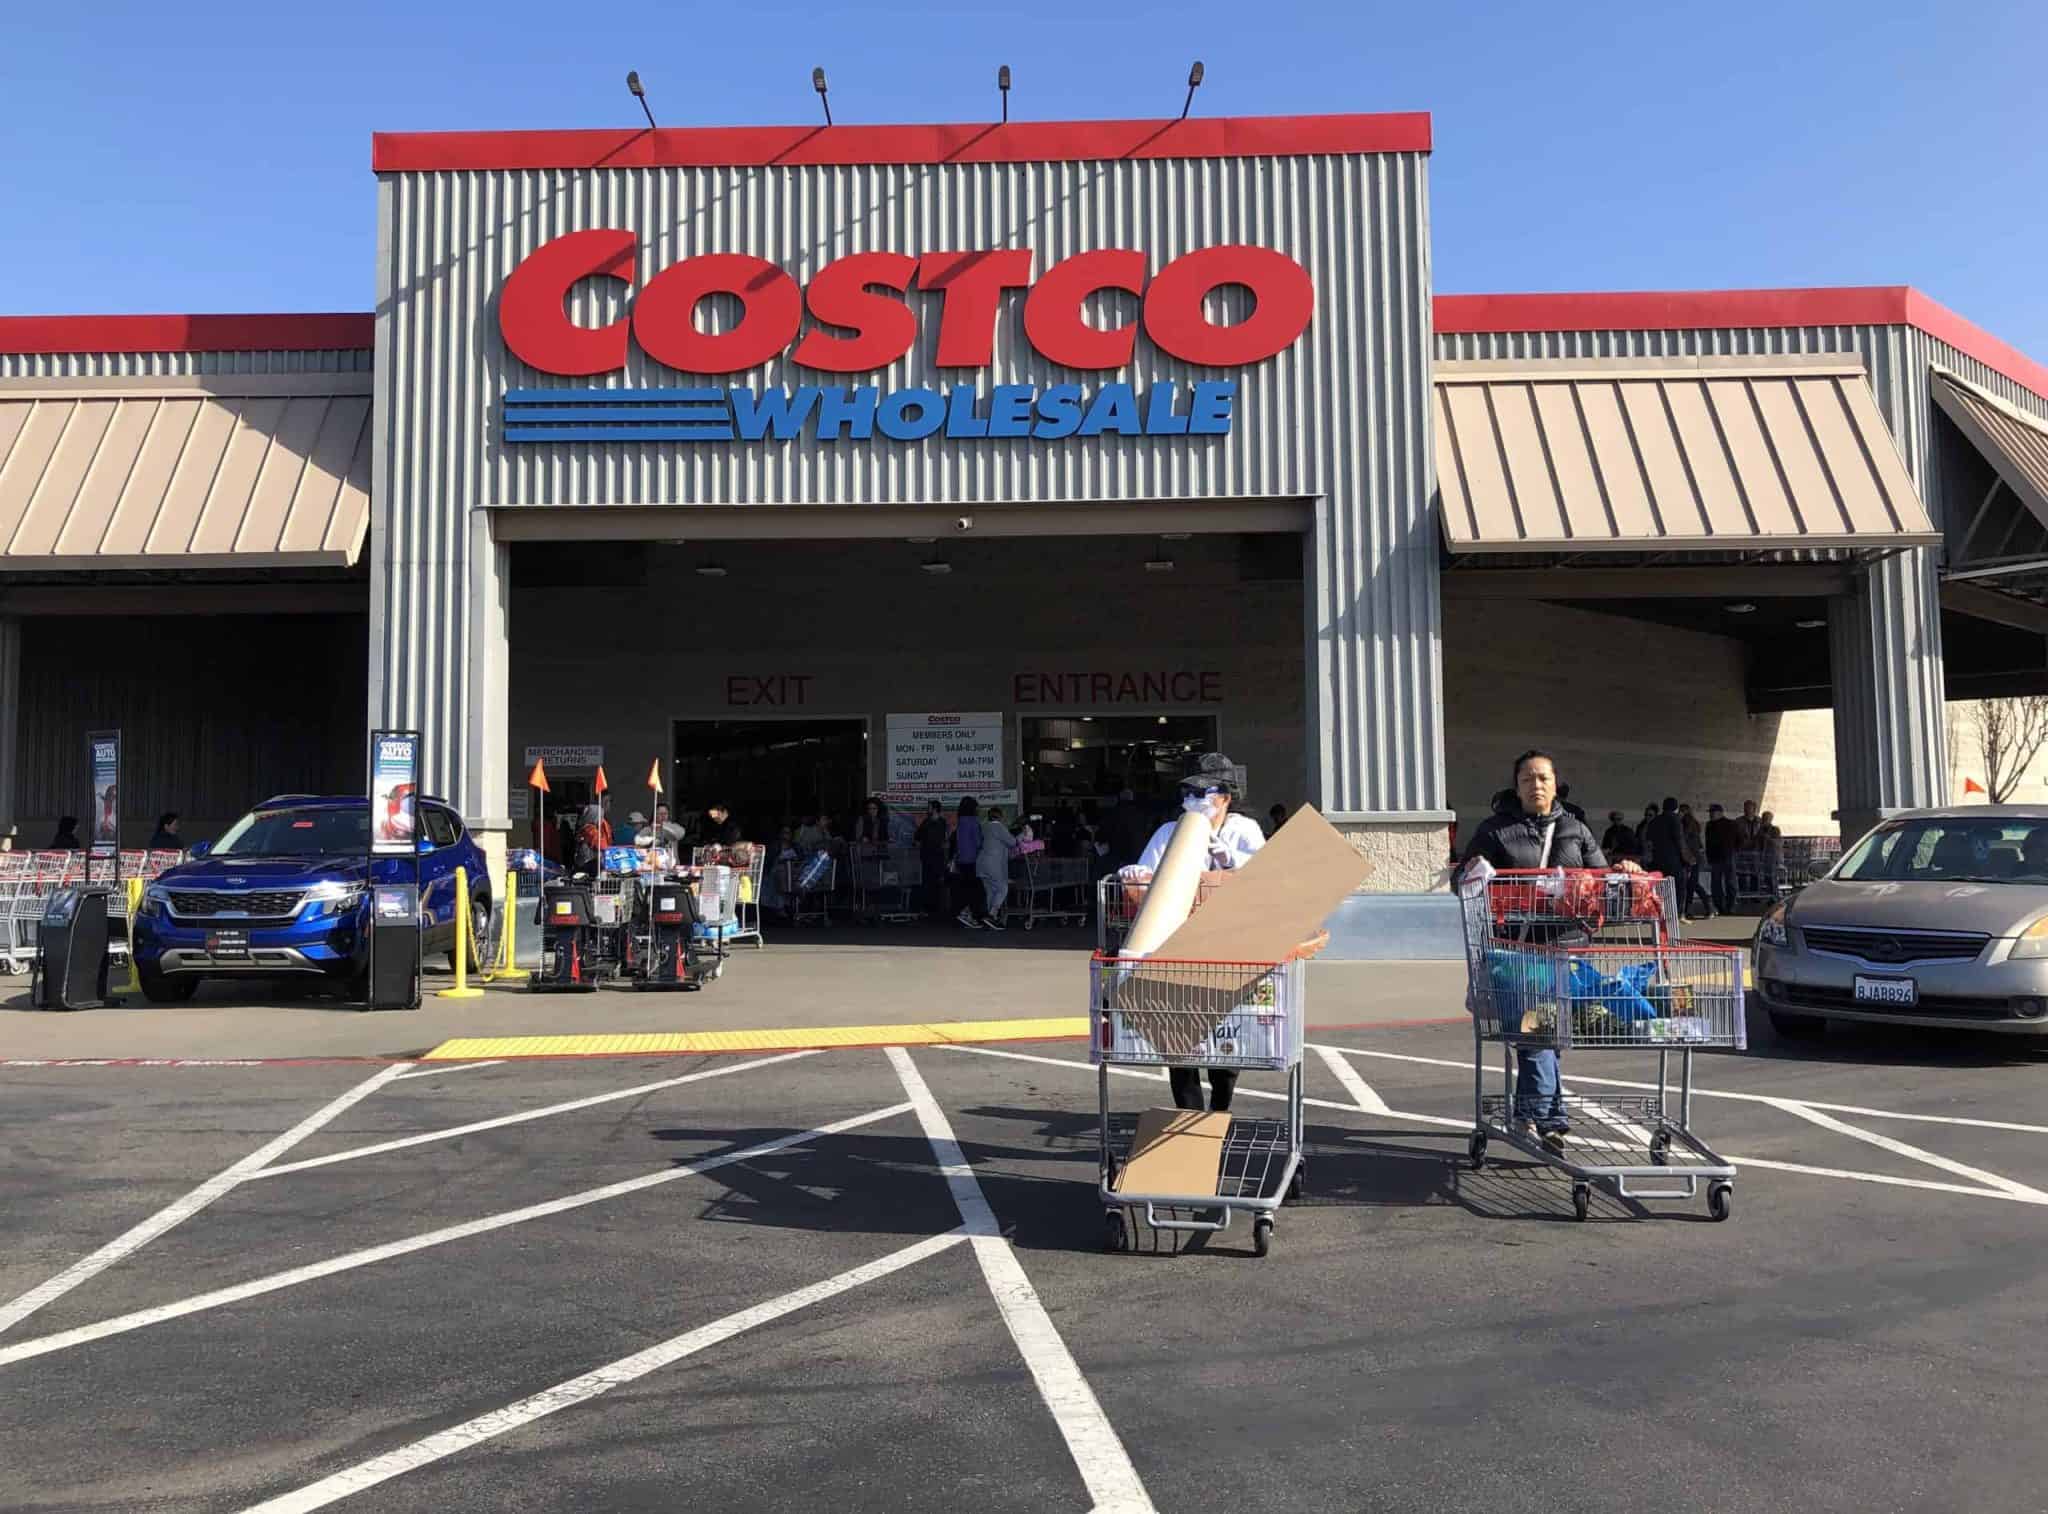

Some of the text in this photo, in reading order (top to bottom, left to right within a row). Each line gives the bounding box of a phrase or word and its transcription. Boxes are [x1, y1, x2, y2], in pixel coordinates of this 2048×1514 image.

[498, 228, 1314, 377] COSTCO
[731, 381, 1236, 441] WHOLESALE
[727, 676, 813, 704] EXIT
[1014, 671, 1223, 704] ENTRANCE
[955, 730, 976, 738] ONLY
[380, 747, 412, 756] AUTO
[896, 757, 937, 766] SATURDAY
[896, 771, 928, 779] SUNDAY
